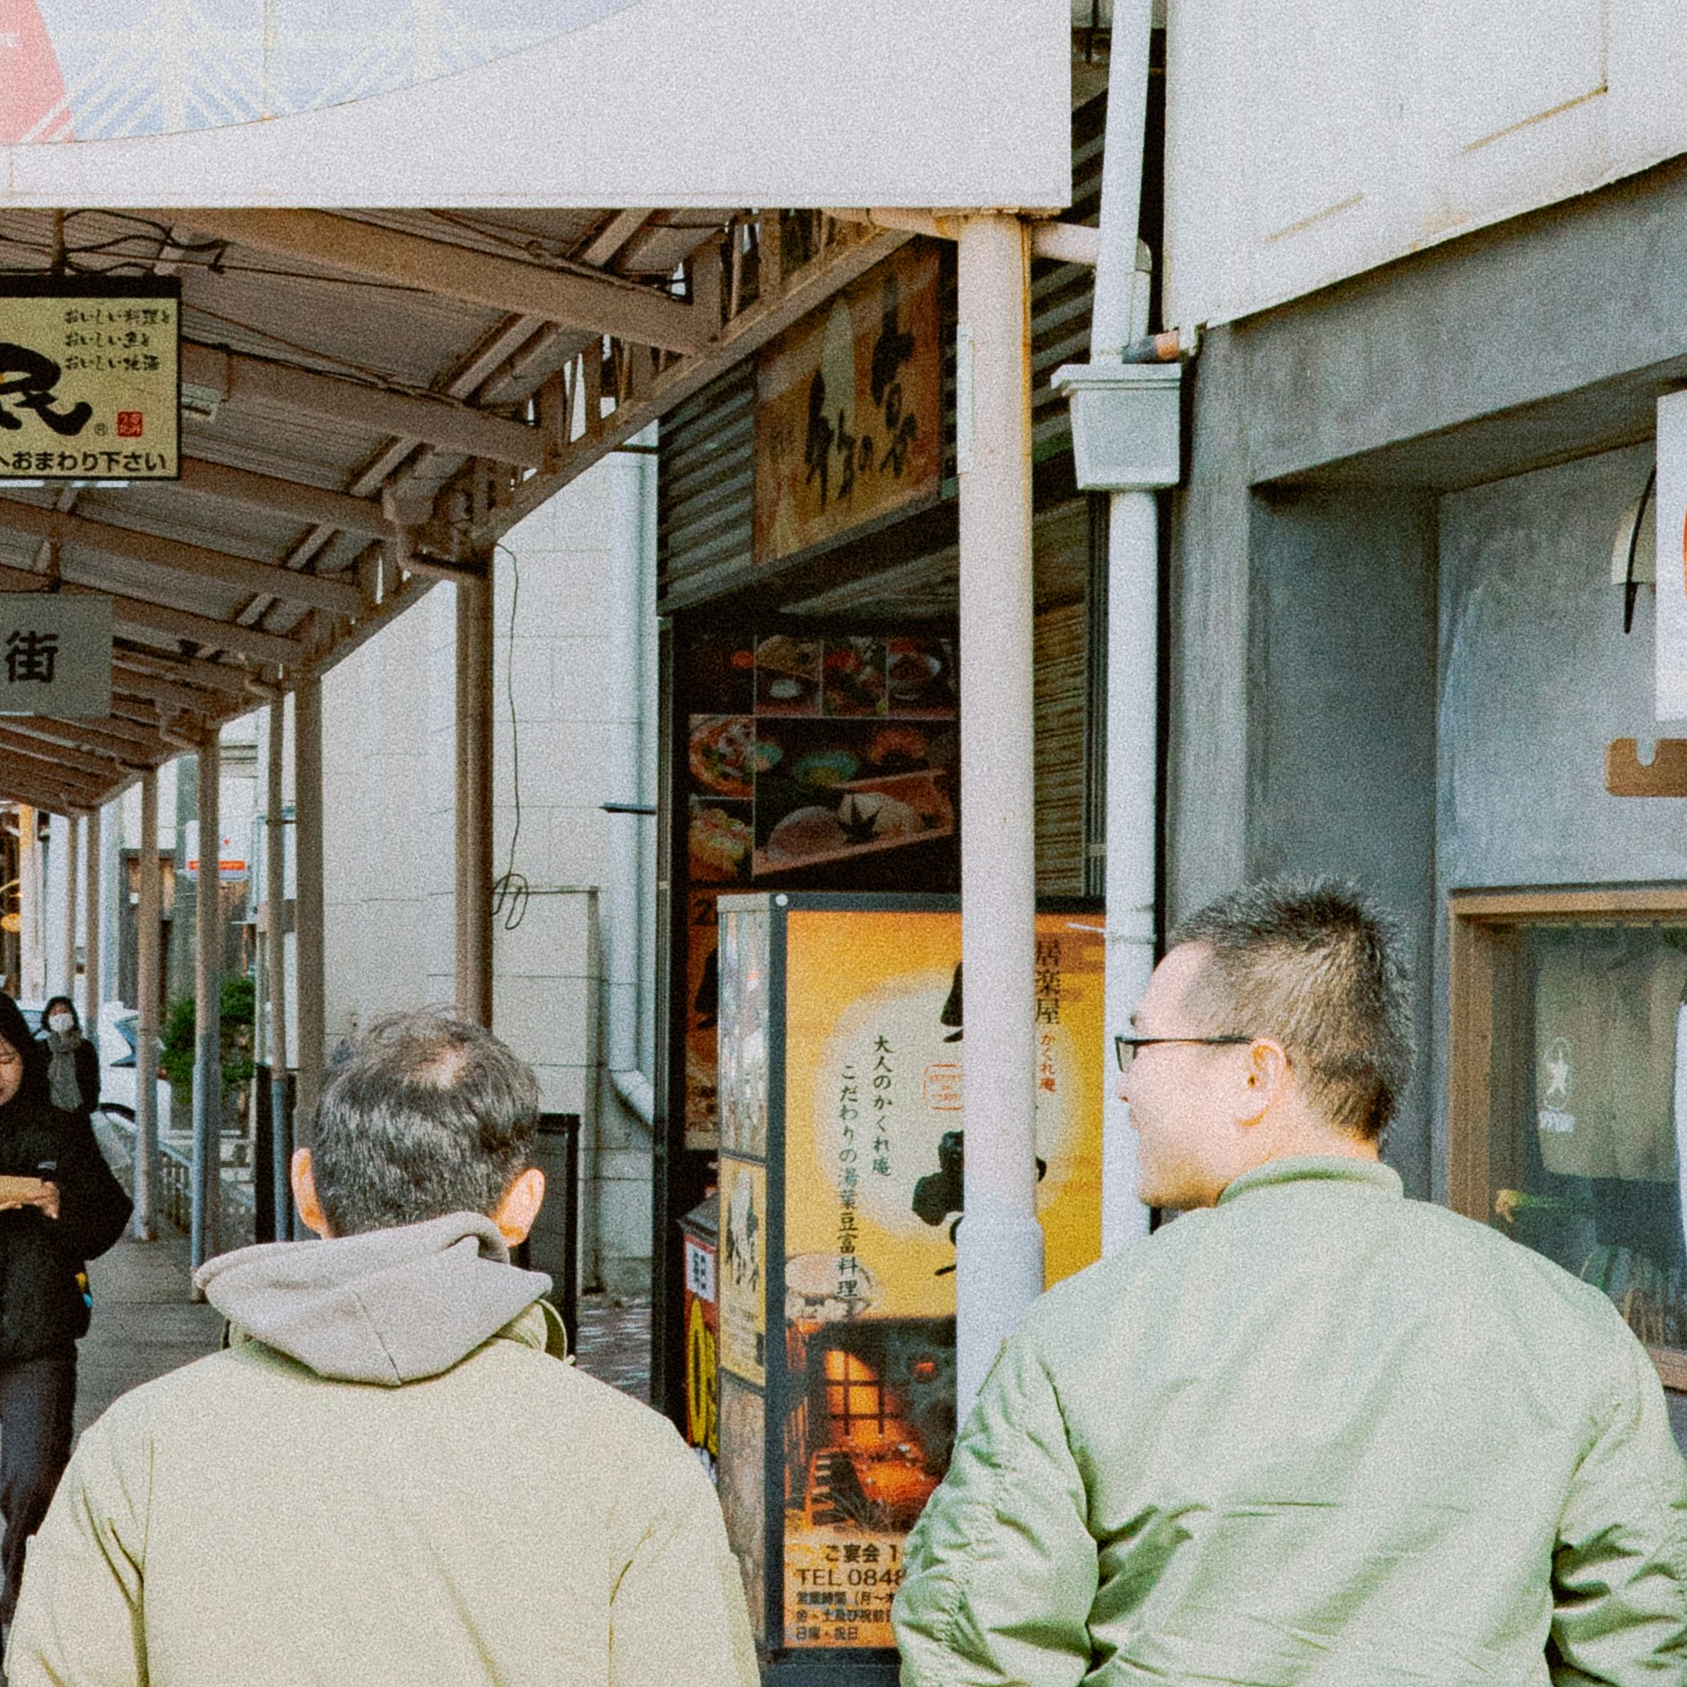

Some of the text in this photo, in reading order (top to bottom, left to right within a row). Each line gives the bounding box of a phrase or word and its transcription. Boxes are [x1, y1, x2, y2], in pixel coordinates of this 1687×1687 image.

[1035, 938, 1061, 1025] 居楽屋
[1038, 1034, 1057, 1093] かくれ庵
[873, 1035, 893, 1176] 大人のかくれ庵
[836, 1065, 859, 1299] こだわりの湯葉豆富料理
[796, 1568, 842, 1587] TEL
[825, 1542, 880, 1563] ご宴会
